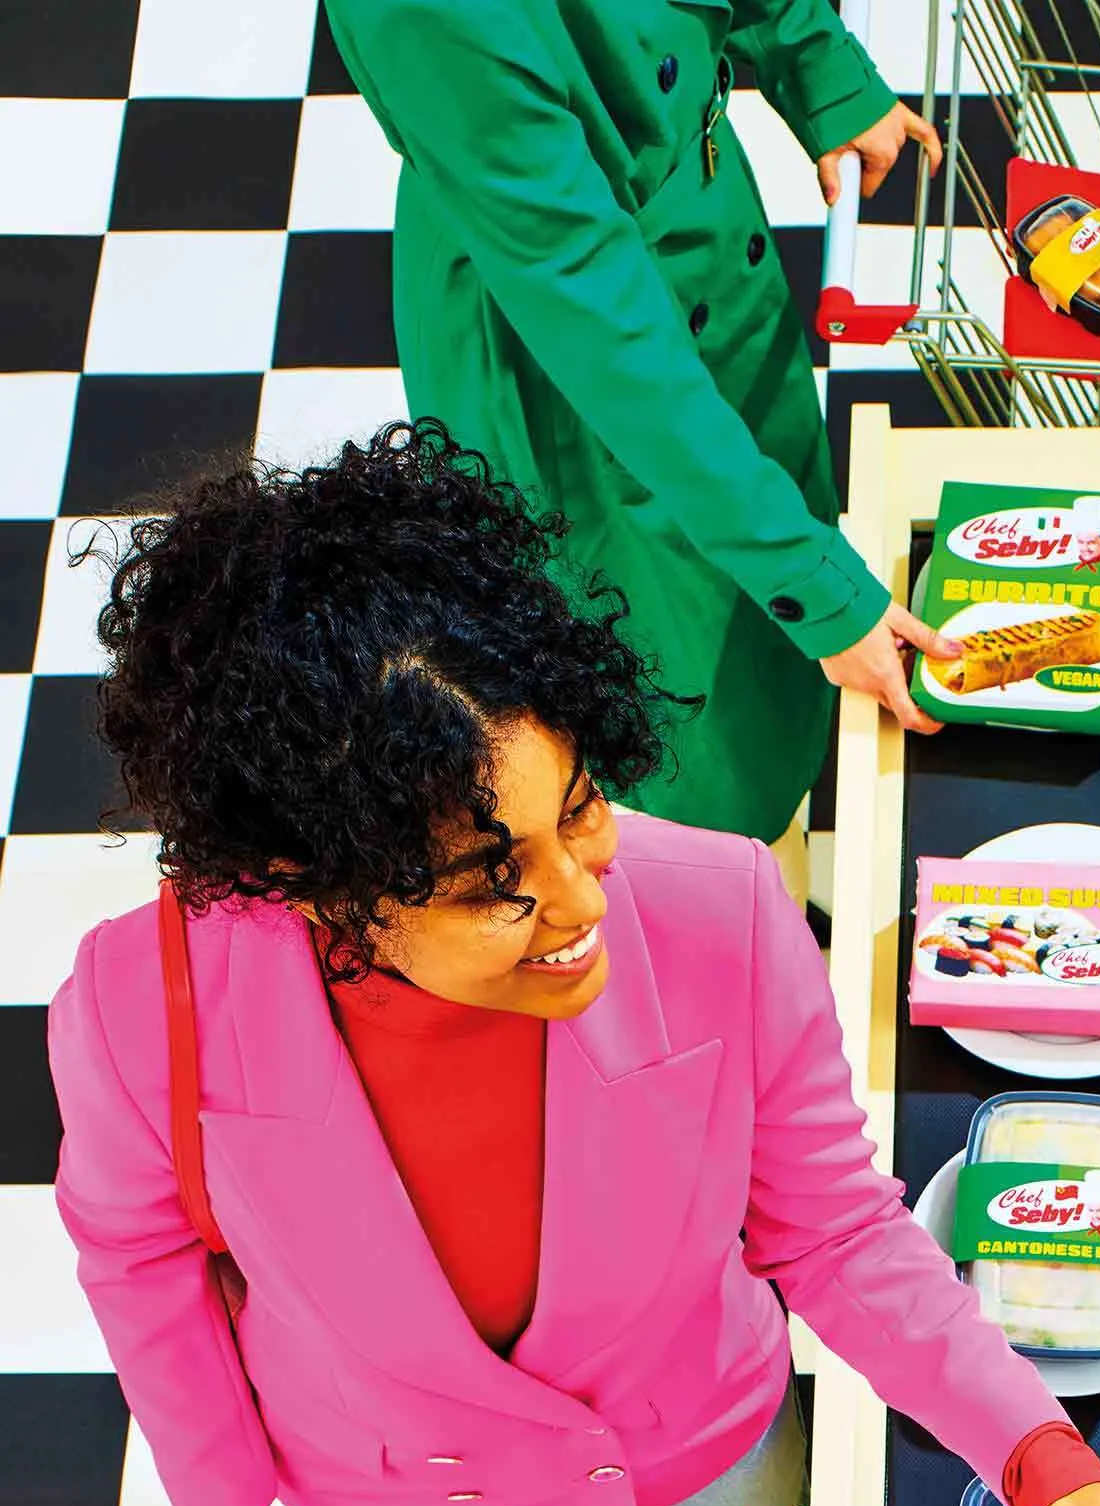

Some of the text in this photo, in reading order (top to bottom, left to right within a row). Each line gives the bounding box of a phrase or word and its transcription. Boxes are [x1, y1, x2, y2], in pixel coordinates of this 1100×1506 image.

[962, 518, 1021, 541] Chef
[975, 534, 1072, 560] Seby!
[932, 883, 1044, 907] MIXED
[1051, 951, 1090, 967] Chef
[998, 1189, 1044, 1208] Chef
[1008, 1203, 1085, 1226] Seby!
[977, 1241, 1094, 1258] CANTONESE
